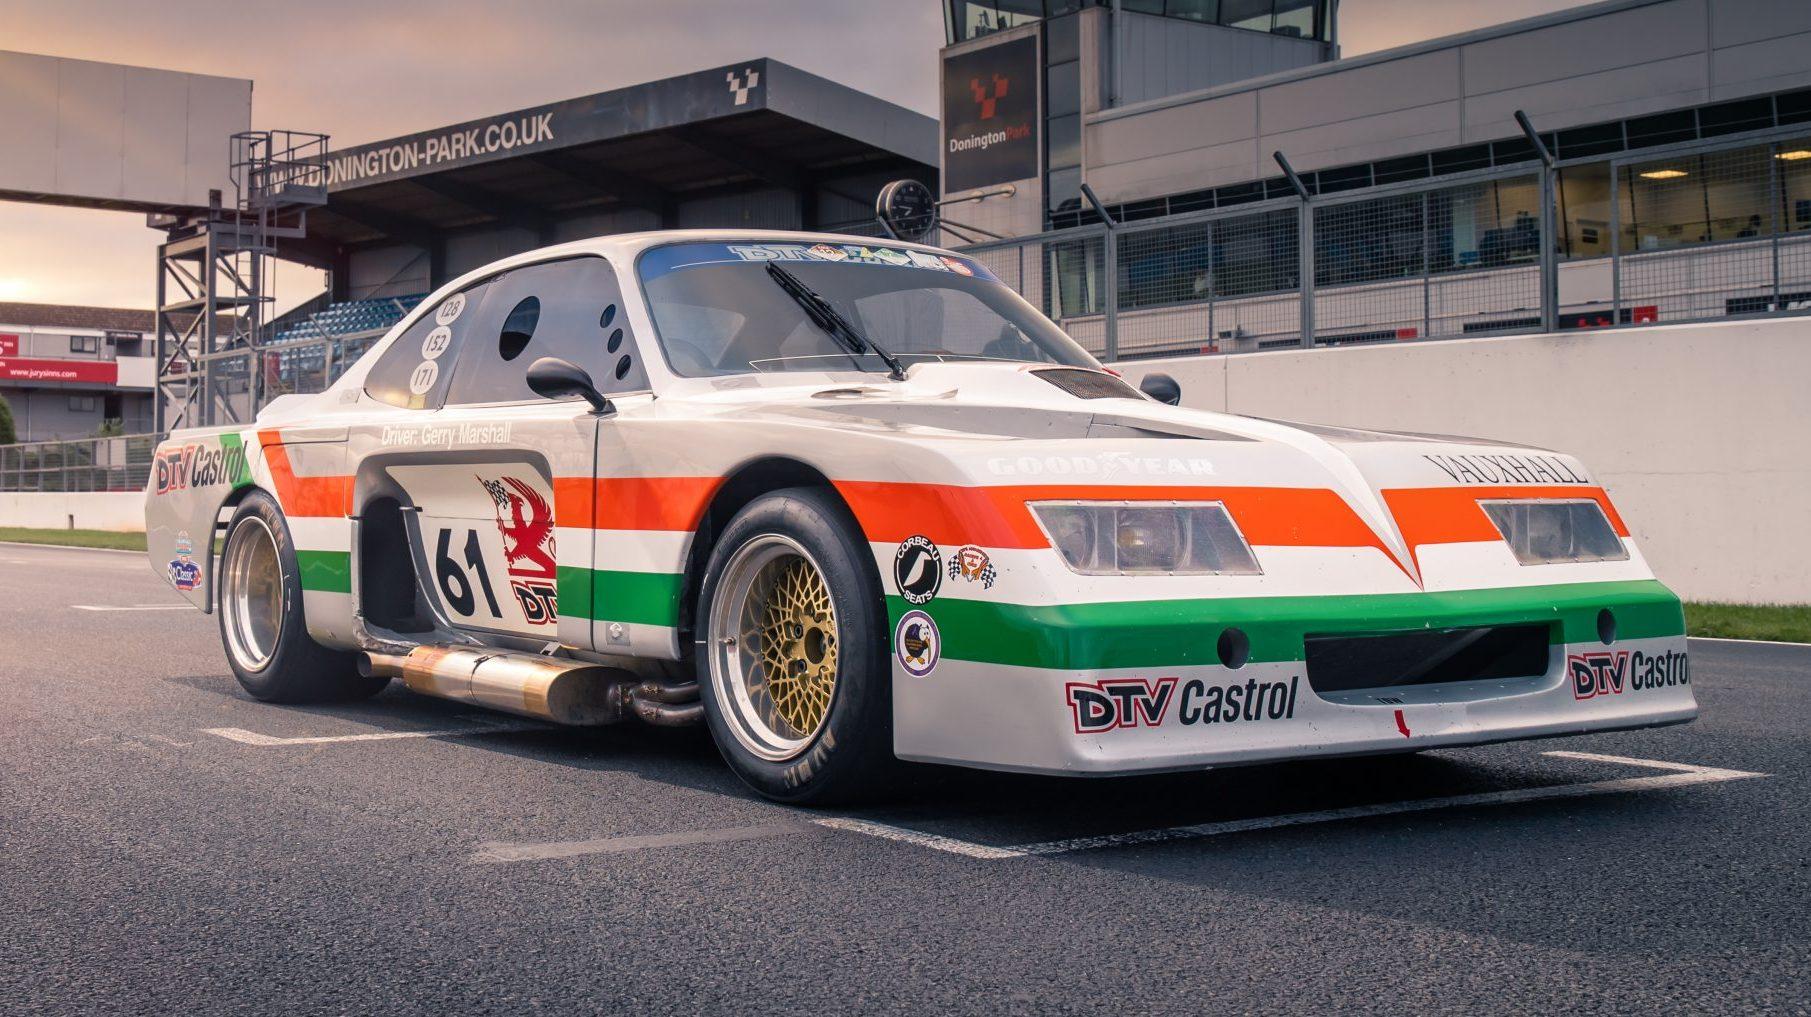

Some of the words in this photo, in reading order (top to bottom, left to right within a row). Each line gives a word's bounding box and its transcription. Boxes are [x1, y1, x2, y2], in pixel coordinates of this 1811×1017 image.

[441, 301, 461, 318] 128
[426, 334, 447, 352] 152
[10, 368, 77, 379] www.jurysinns.com
[414, 368, 434, 387] 171
[381, 424, 418, 446] Driver:
[421, 424, 457, 450] Gerry
[459, 421, 513, 445] Marshall
[157, 445, 194, 495] DTV
[191, 440, 248, 488] Castrol
[1421, 455, 1589, 483] VAUXHALL
[897, 536, 940, 561] CORBEAU
[436, 528, 503, 618] 61
[510, 580, 557, 625] DT
[904, 589, 933, 604] SEATS
[1567, 651, 1629, 700] DTV
[1631, 649, 1691, 691] Castro
[1066, 677, 1179, 734] DTV
[1179, 676, 1299, 726] Castrol
